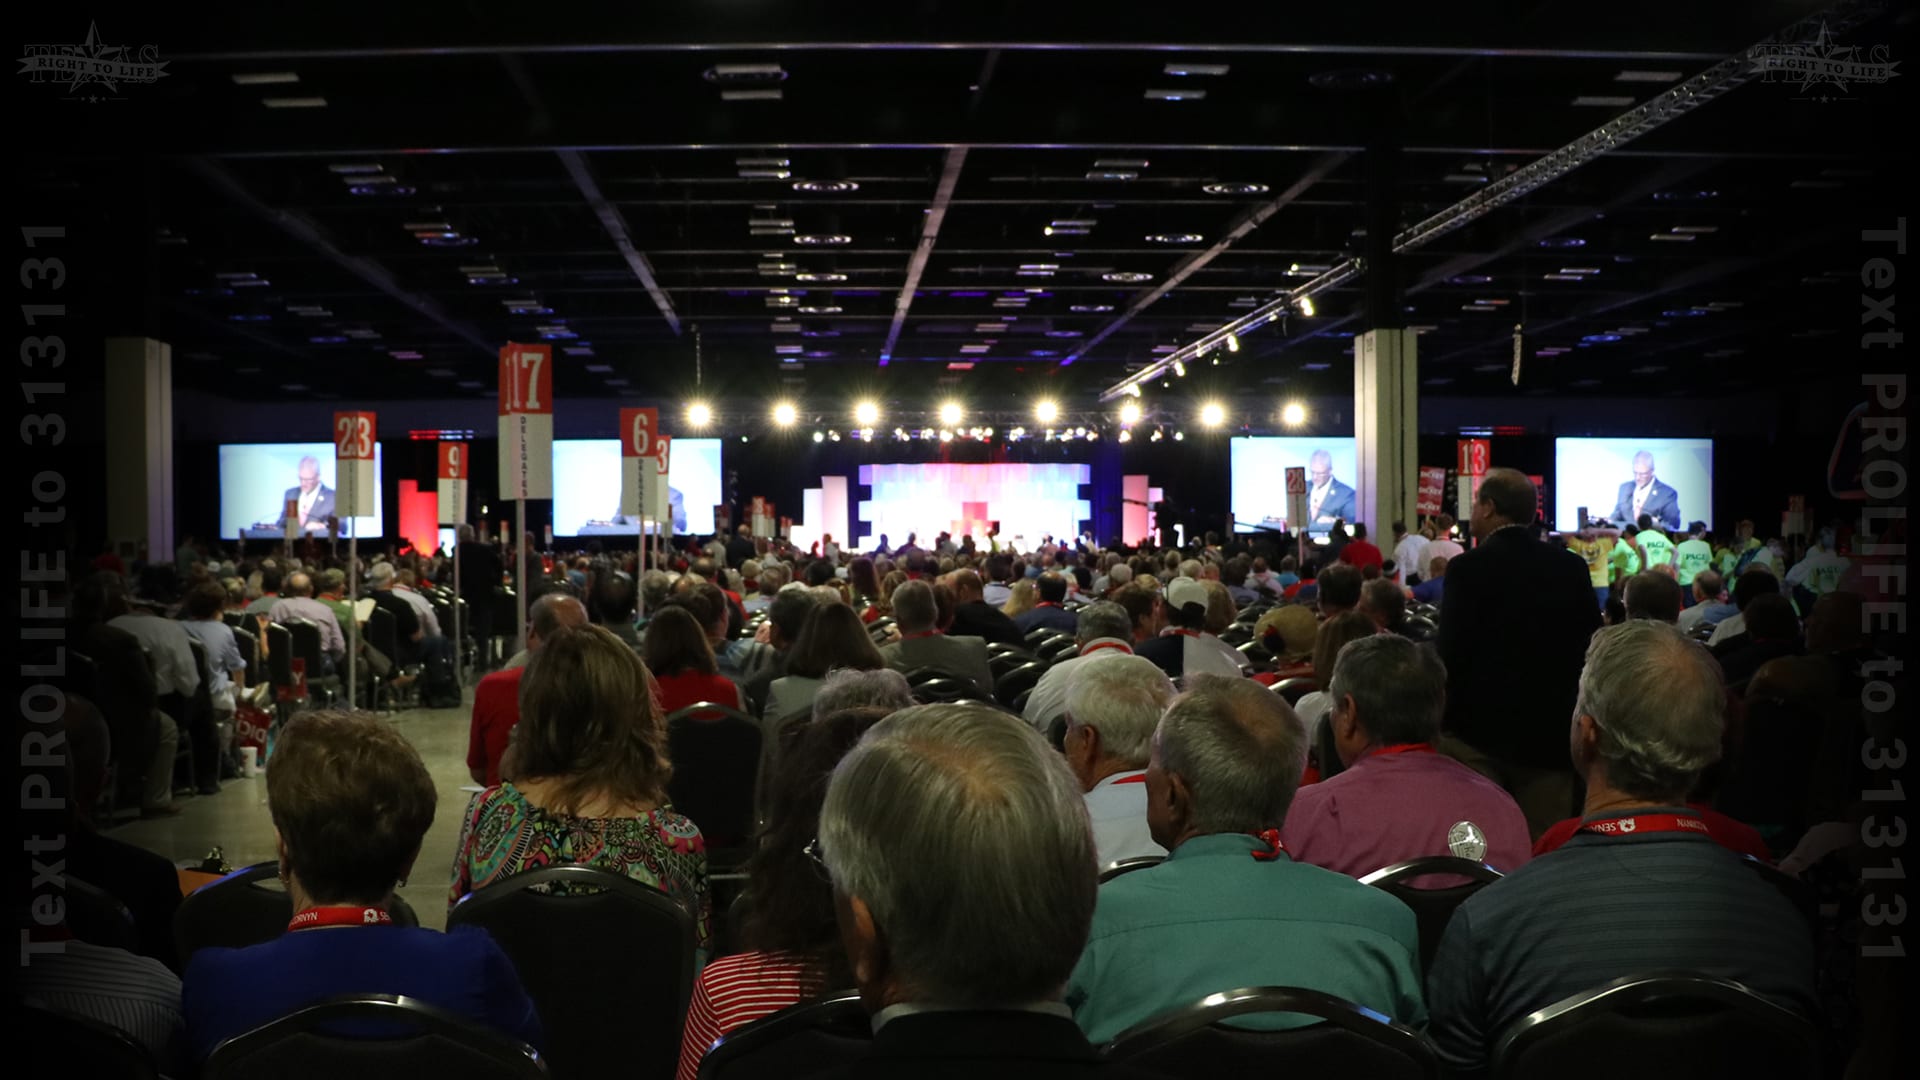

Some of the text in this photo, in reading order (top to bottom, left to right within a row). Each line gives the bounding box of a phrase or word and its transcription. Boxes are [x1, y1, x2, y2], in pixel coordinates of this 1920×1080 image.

[633, 413, 648, 455] 6
[448, 446, 459, 477] 9
[520, 416, 528, 497] DELEGATES
